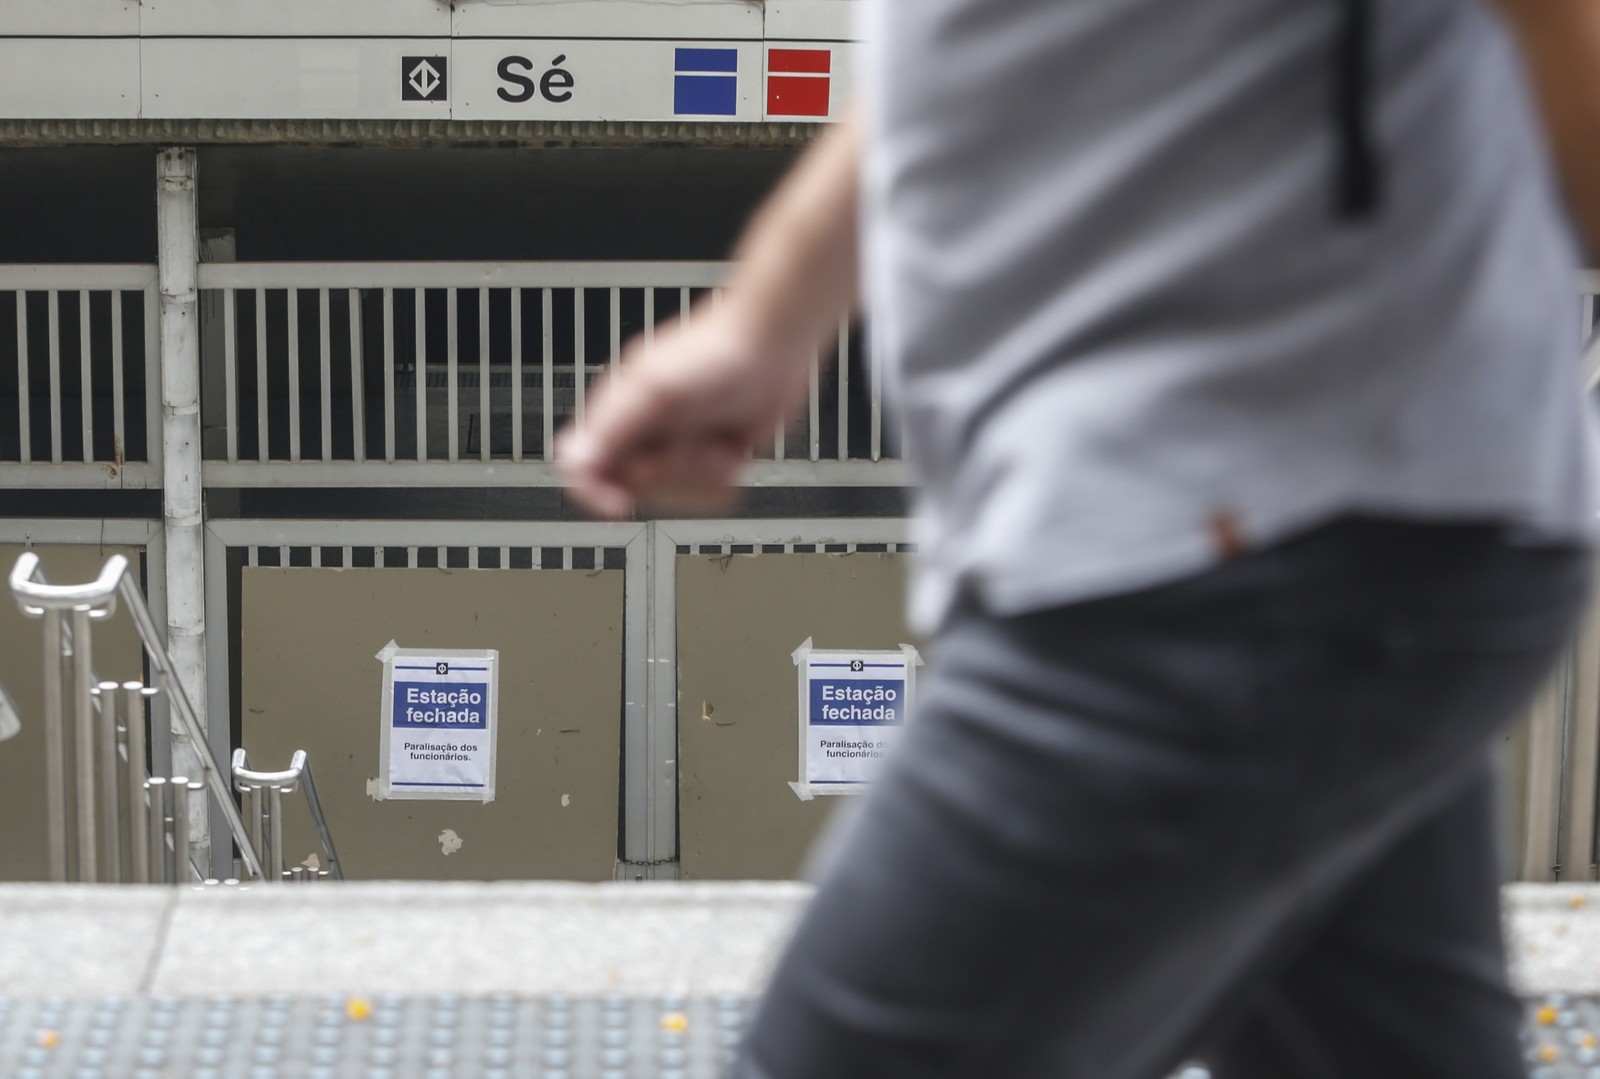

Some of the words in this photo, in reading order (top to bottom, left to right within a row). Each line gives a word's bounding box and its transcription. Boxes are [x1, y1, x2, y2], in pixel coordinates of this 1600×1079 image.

[496, 54, 575, 103] Sé
[407, 688, 481, 707] Estação
[822, 685, 896, 704] Estação
[406, 708, 480, 723] fechada
[822, 705, 895, 720] fechada
[404, 743, 458, 753] Paralisação
[460, 744, 478, 752] dos
[820, 740, 874, 750] Paralisação
[876, 741, 889, 749] do
[410, 752, 471, 761] funcionários.
